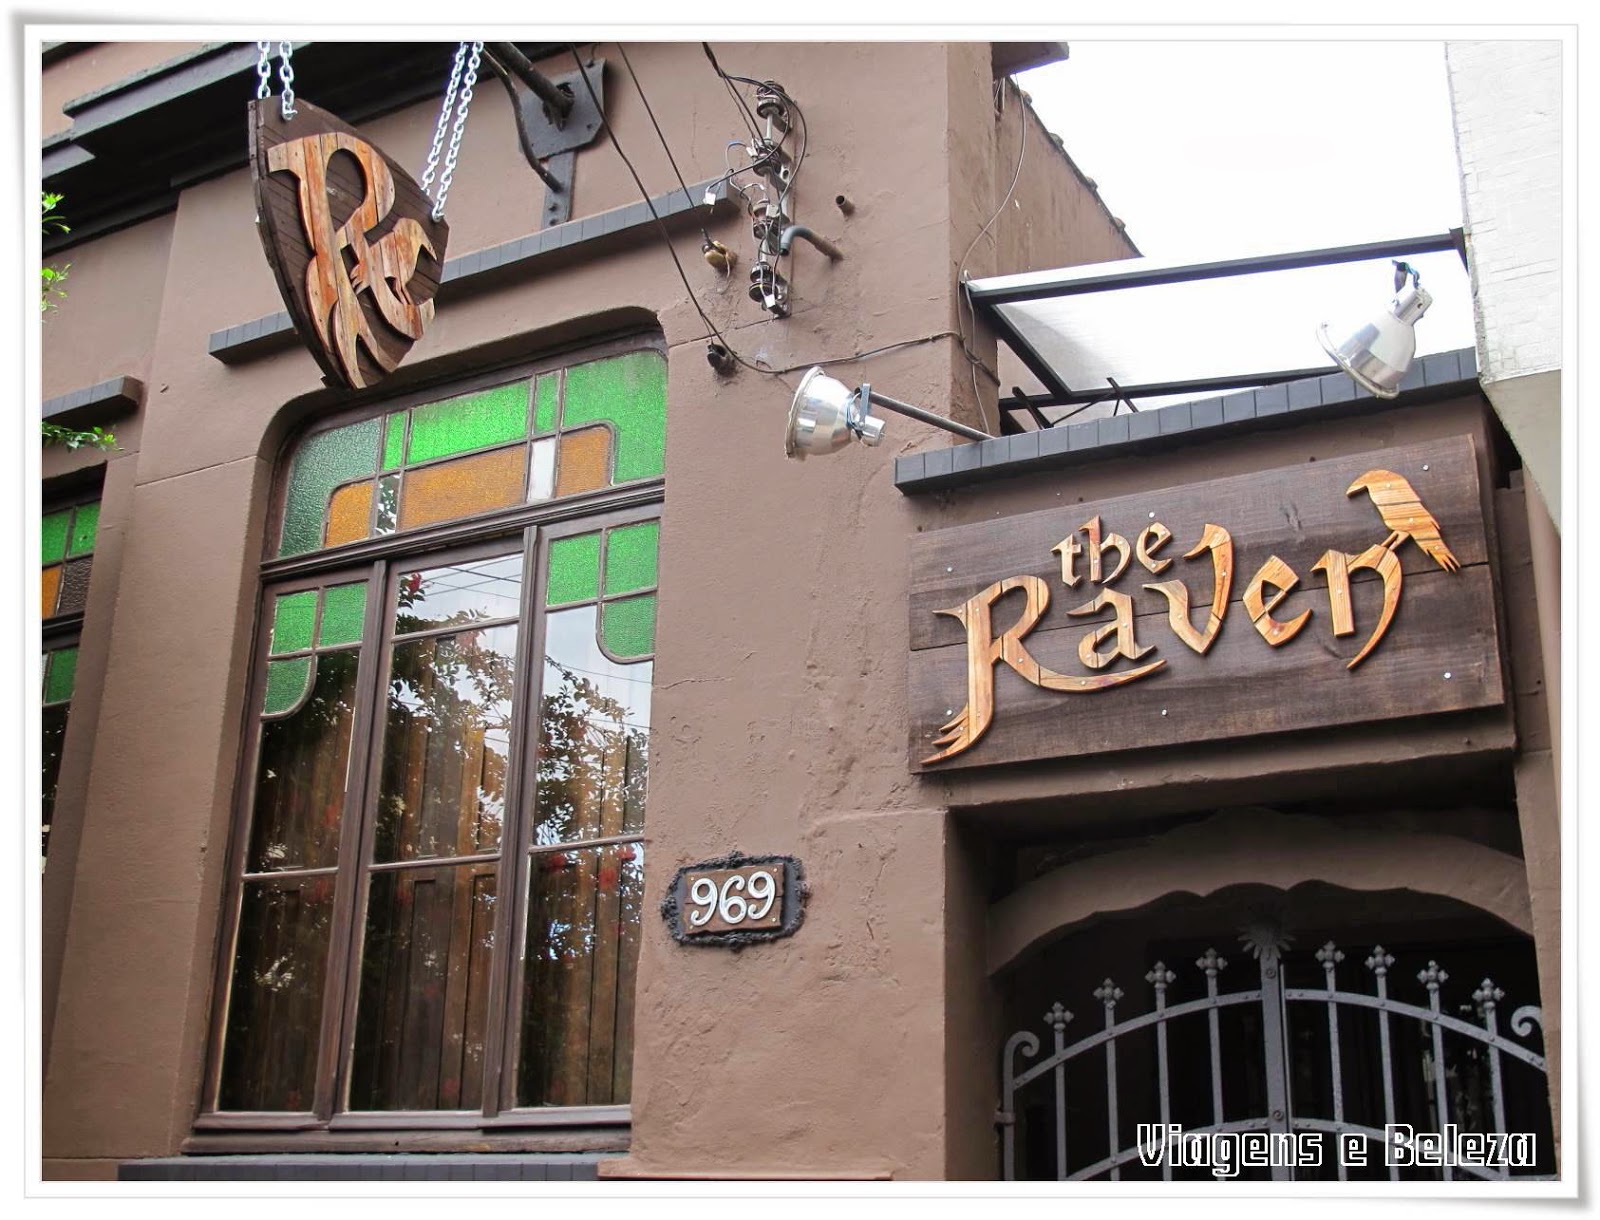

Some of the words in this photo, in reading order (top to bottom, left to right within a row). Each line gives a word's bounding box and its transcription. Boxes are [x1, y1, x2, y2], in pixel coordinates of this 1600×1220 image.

[1050, 515, 1174, 588] the
[919, 523, 1403, 766] Raven
[690, 871, 776, 927] 969
